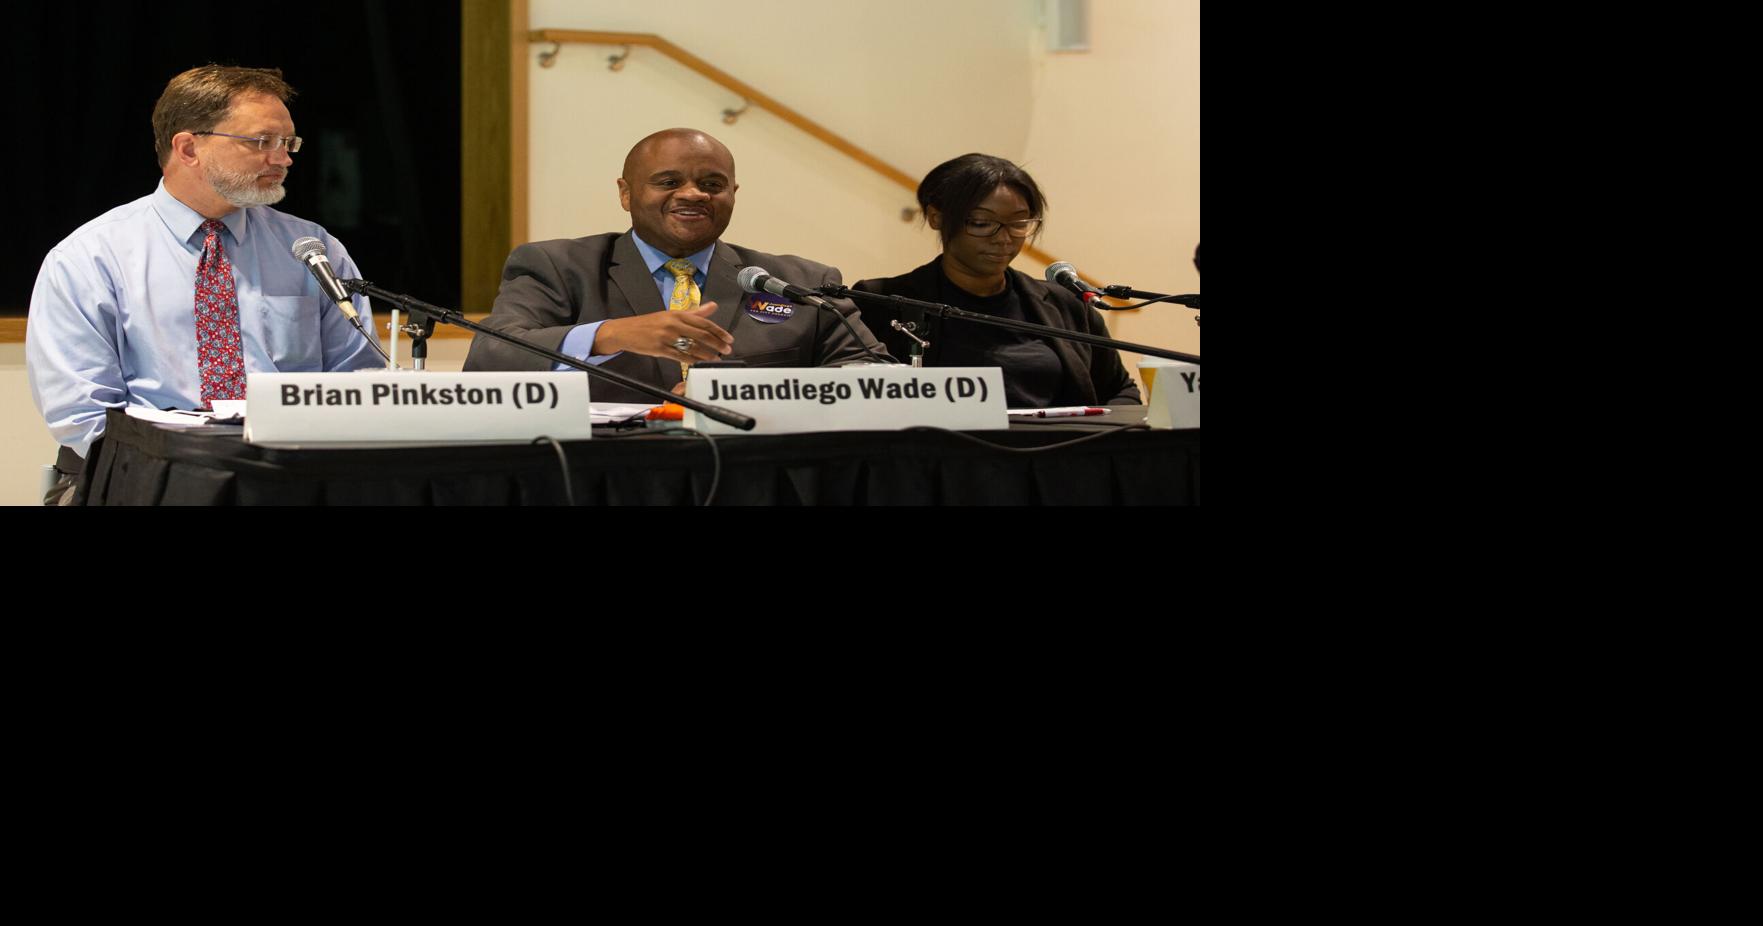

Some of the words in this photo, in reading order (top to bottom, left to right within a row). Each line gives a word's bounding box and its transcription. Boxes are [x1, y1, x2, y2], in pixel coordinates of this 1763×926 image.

[751, 299, 792, 314] Wade
[708, 378, 852, 405] Juandiego
[857, 377, 937, 400] Wade
[944, 376, 988, 403] (D)
[1180, 371, 1200, 393] Y
[281, 384, 362, 406] Brian
[372, 383, 503, 405] Pinkston
[512, 382, 559, 409] (D)
